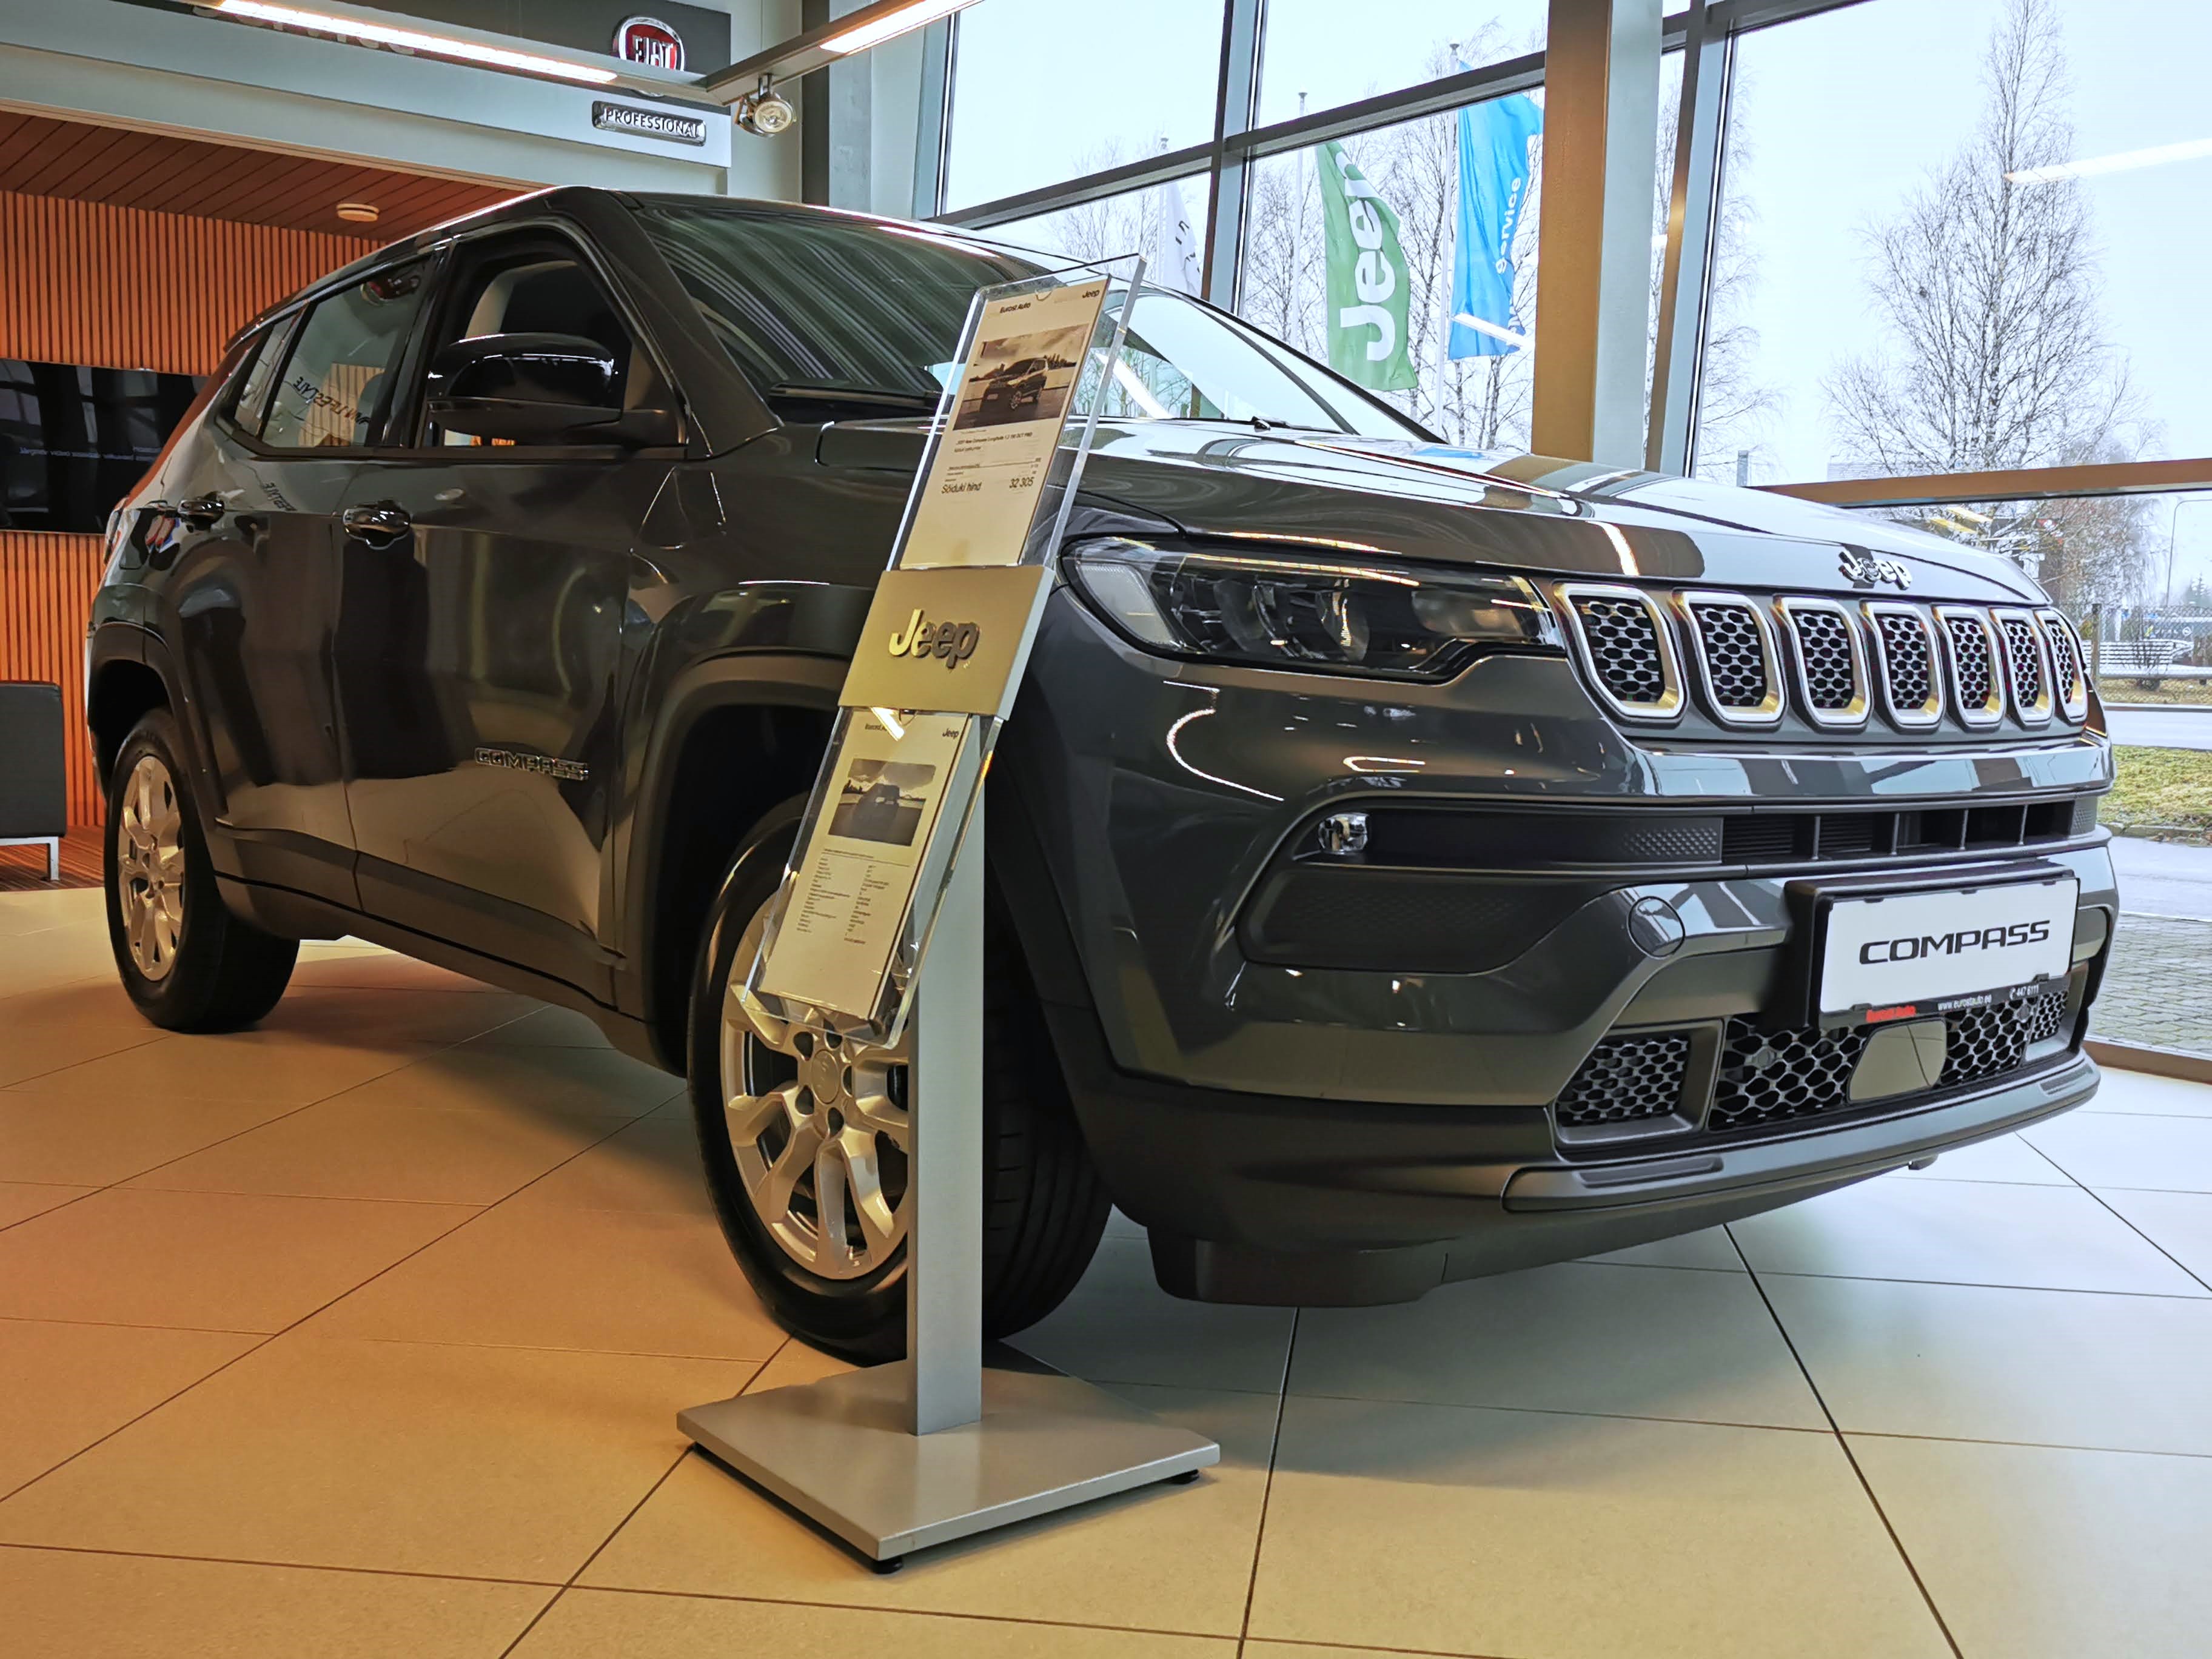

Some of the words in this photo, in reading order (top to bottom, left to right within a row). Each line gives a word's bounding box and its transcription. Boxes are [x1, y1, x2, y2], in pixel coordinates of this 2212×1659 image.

[635, 36, 674, 69] FIAT
[604, 107, 699, 138] PROFESSIONAL
[1495, 177, 1521, 274] service
[1335, 151, 1395, 362] Jeep
[1082, 290, 1100, 299] Jeep
[967, 481, 982, 492] hind
[1838, 548, 1913, 591] Jeep
[888, 608, 979, 669] Jeep
[942, 728, 959, 739] Jeep
[475, 746, 589, 781] COMPASS
[1859, 919, 2050, 965] COMPASS
